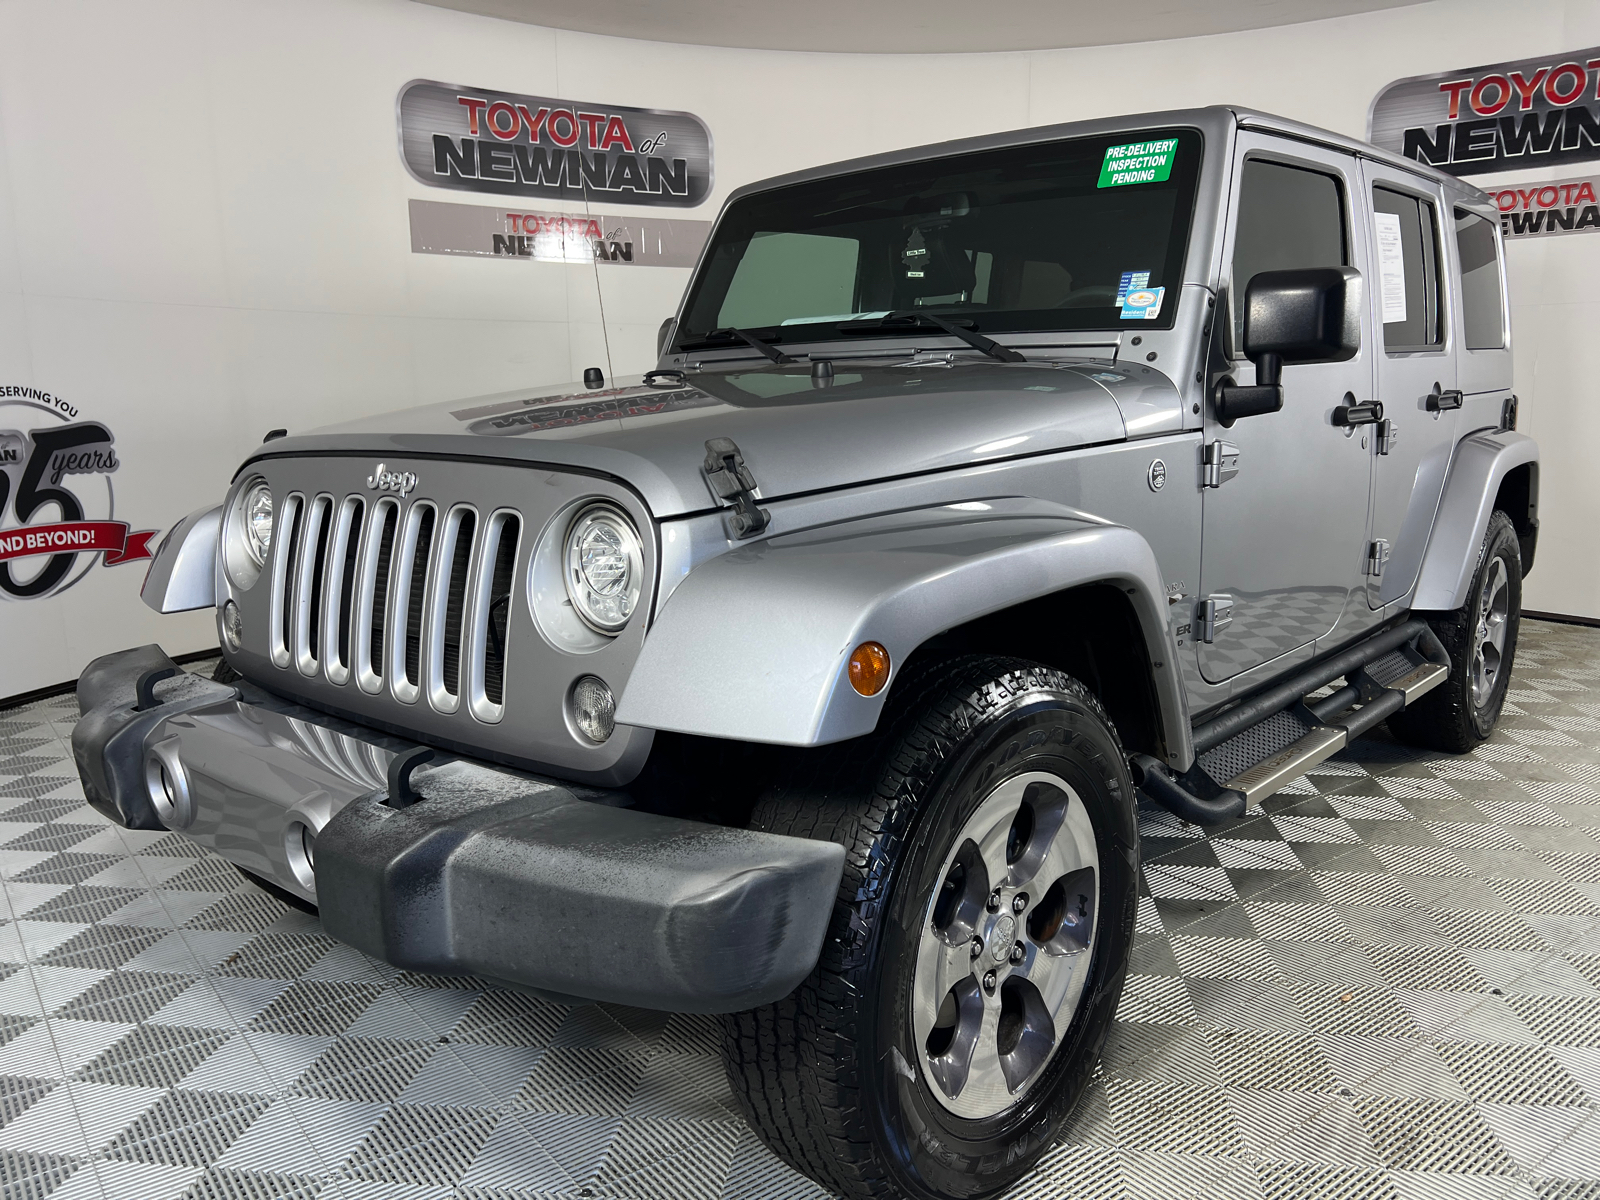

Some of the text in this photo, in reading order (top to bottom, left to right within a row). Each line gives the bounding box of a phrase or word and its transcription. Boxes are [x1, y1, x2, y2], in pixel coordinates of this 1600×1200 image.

[457, 96, 666, 154] TOYOTA of
[1402, 105, 1600, 166] NEWN
[431, 132, 688, 195] NEWNAN
[1106, 140, 1176, 159] PRE-DELIVERY
[1107, 154, 1167, 172] INSPECTION
[1111, 169, 1155, 184] PENDING
[507, 213, 622, 241] TOYOTA of
[492, 233, 634, 263] NEAN
[0, 386, 78, 417] SERVING YOU
[51, 450, 116, 485] years
[367, 463, 417, 498] Jeep
[26, 530, 95, 549] BEYOND!
